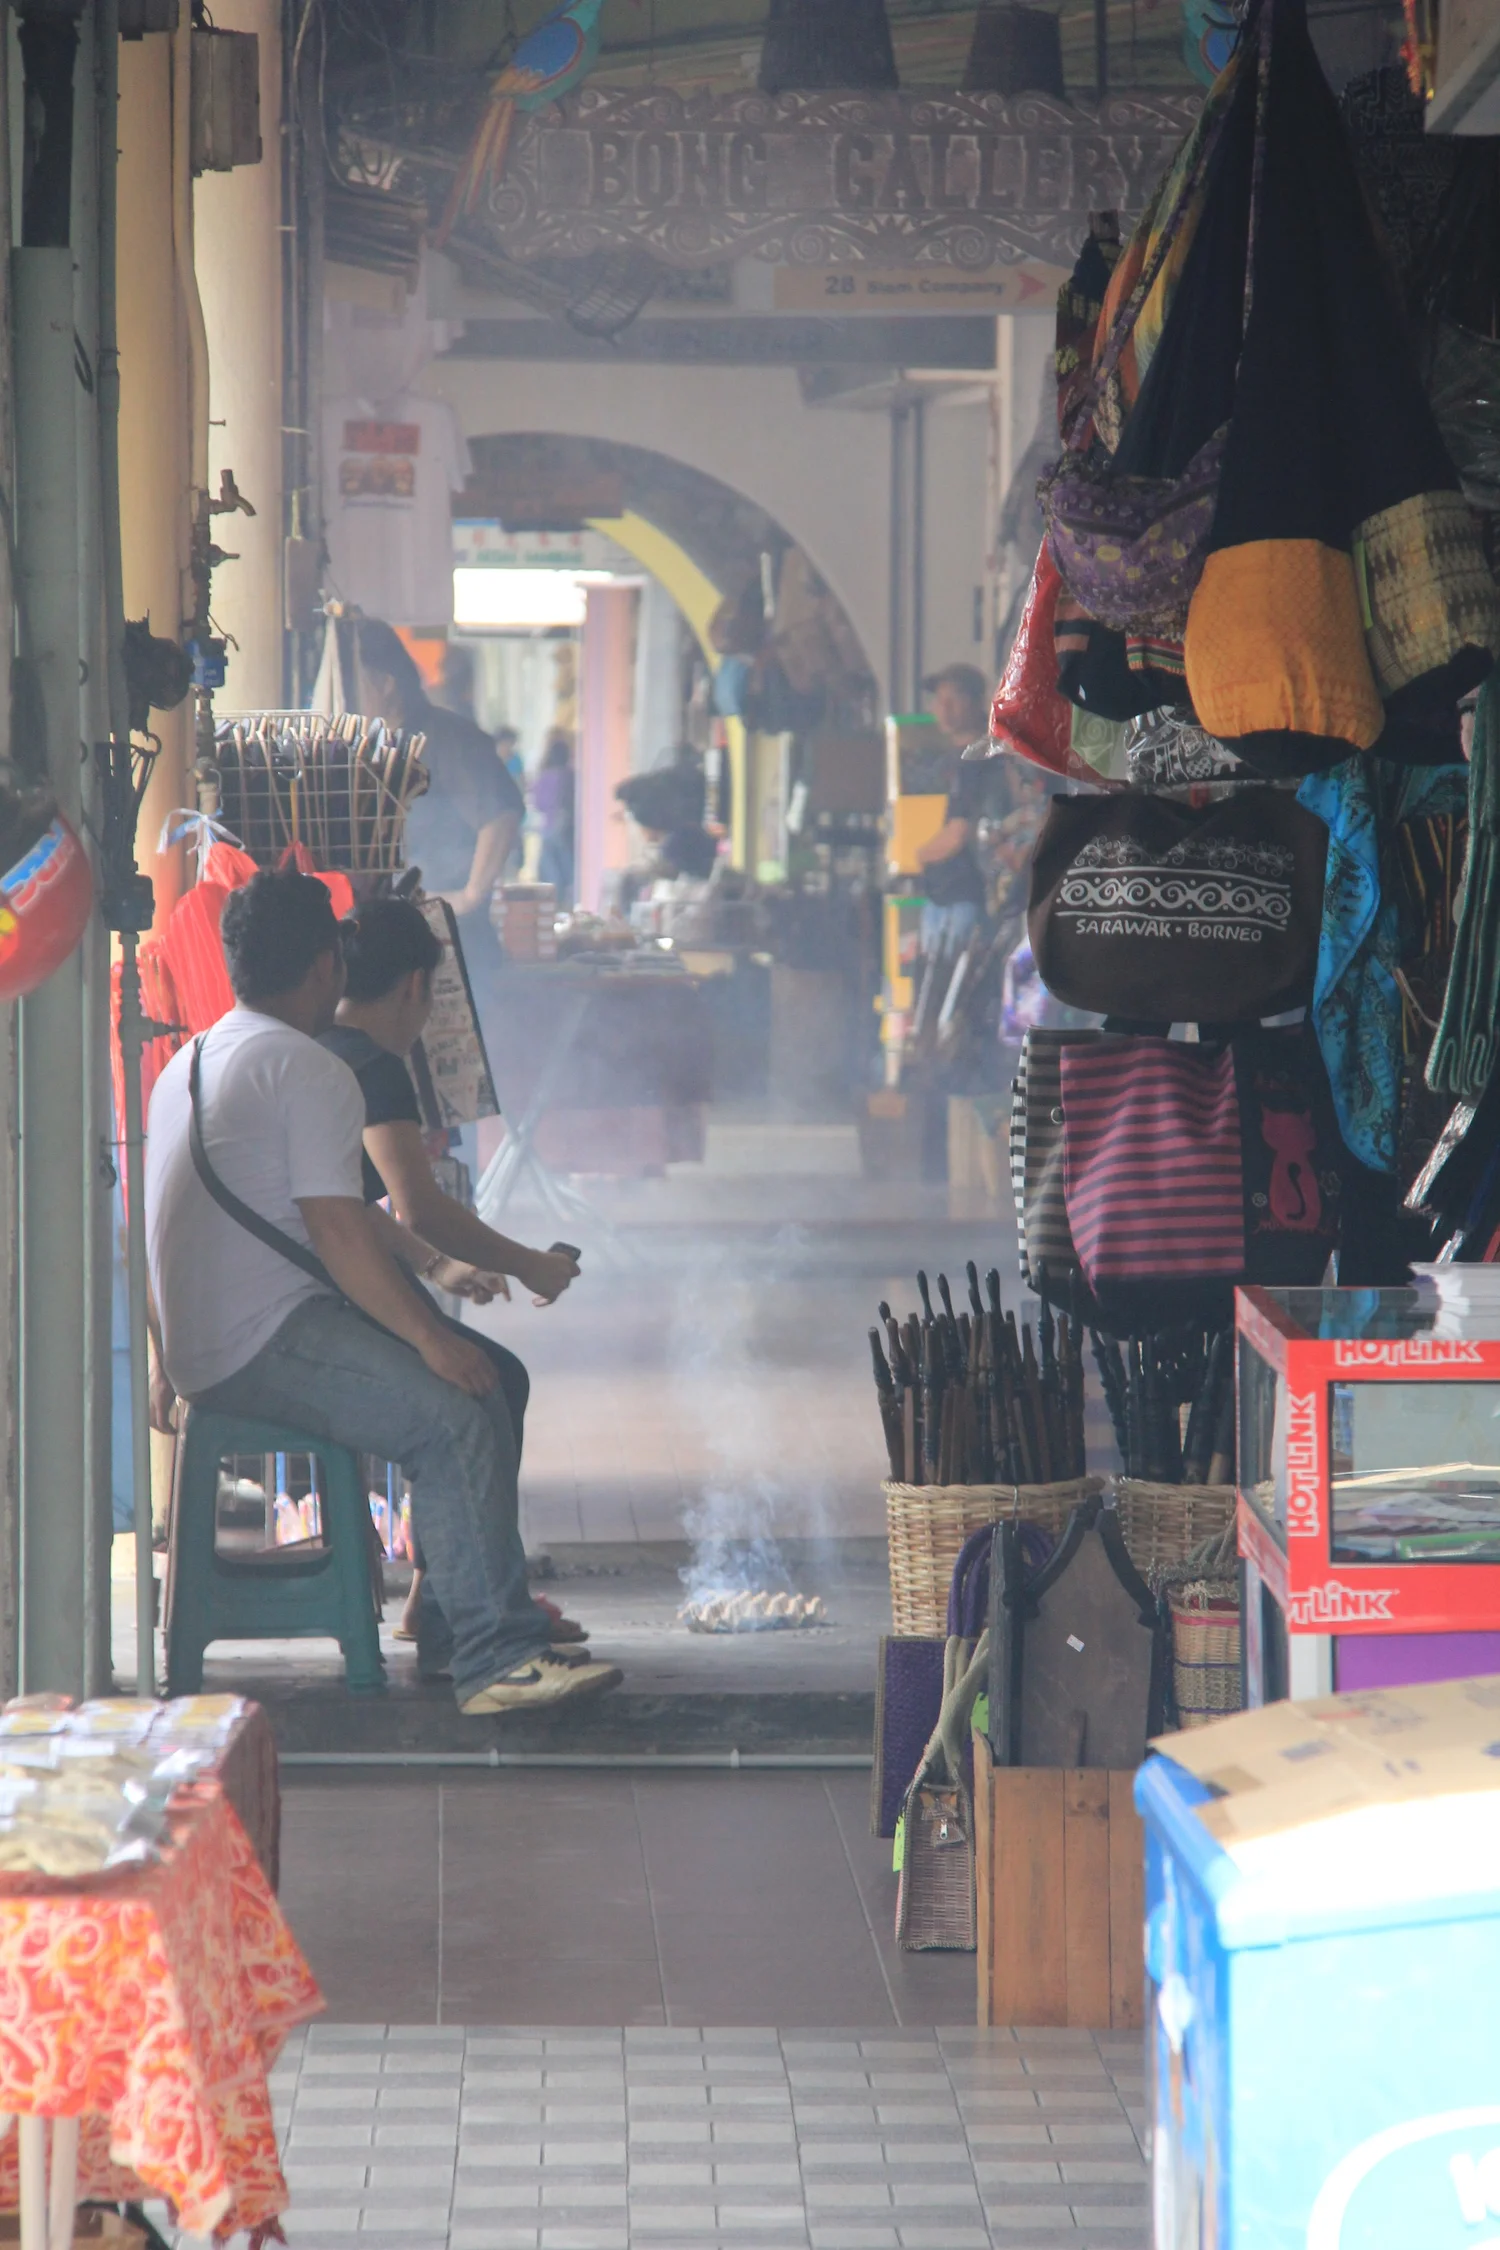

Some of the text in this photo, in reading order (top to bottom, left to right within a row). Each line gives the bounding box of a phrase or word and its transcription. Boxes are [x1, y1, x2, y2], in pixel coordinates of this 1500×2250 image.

[589, 129, 1166, 210] BONG GALLERY
[918, 277, 1006, 296] Company
[1075, 918, 1263, 942] SARAWAK BORNEO
